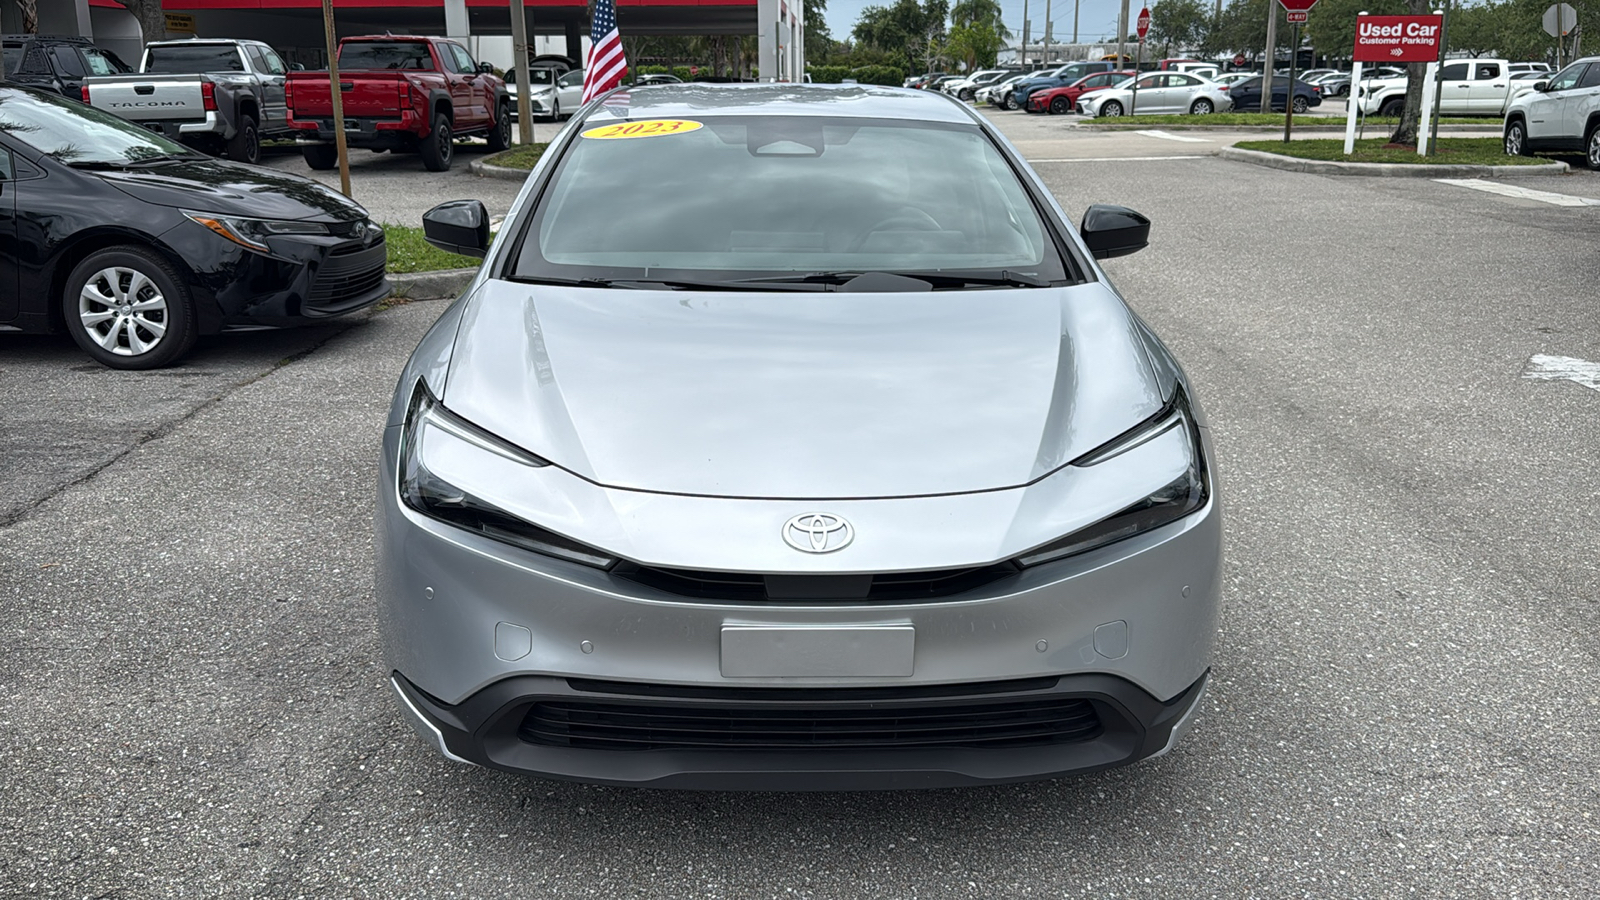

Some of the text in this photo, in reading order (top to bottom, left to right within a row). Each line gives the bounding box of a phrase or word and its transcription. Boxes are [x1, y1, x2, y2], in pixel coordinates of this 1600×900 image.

[1138, 17, 1149, 29] STOP
[1360, 22, 1438, 37] Used Car
[1359, 37, 1435, 46] Customer Parking
[601, 121, 684, 137] 2023
